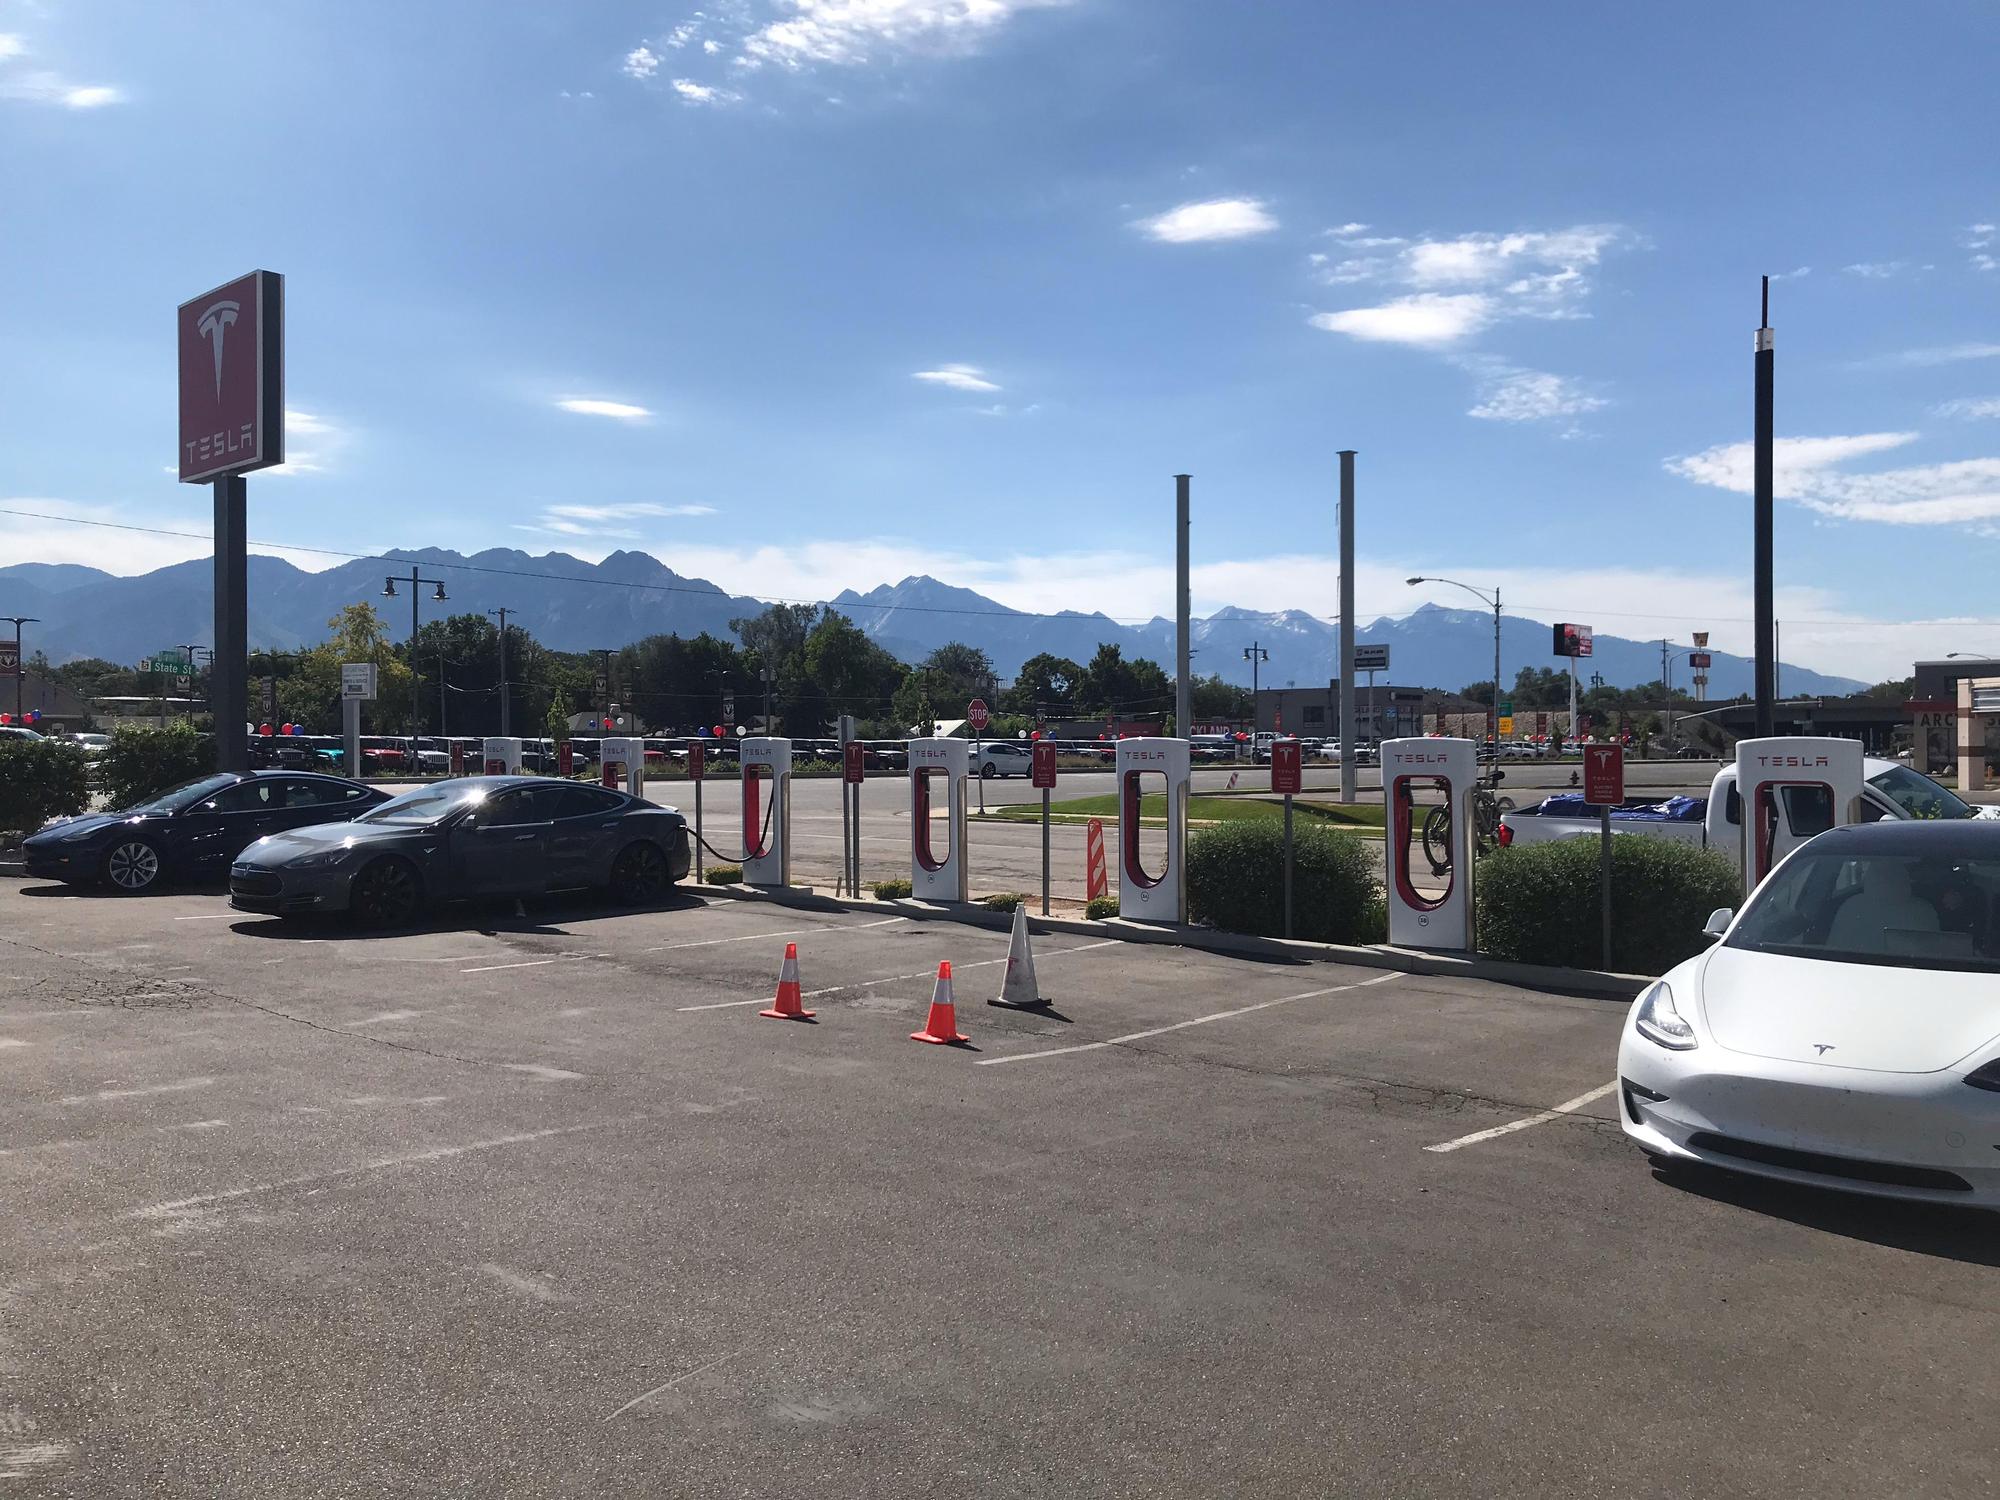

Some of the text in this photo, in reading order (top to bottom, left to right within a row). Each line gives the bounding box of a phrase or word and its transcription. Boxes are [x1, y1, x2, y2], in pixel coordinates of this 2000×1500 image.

[185, 423, 252, 464] TESLA
[154, 662, 178, 673] State
[182, 664, 192, 675] St
[969, 709, 987, 720] STOP
[1920, 712, 1957, 727] ARC
[915, 750, 947, 758] TESLA
[1125, 751, 1165, 760] TESLA
[1394, 754, 1447, 763] TESLA
[1758, 757, 1828, 767] TESLA
